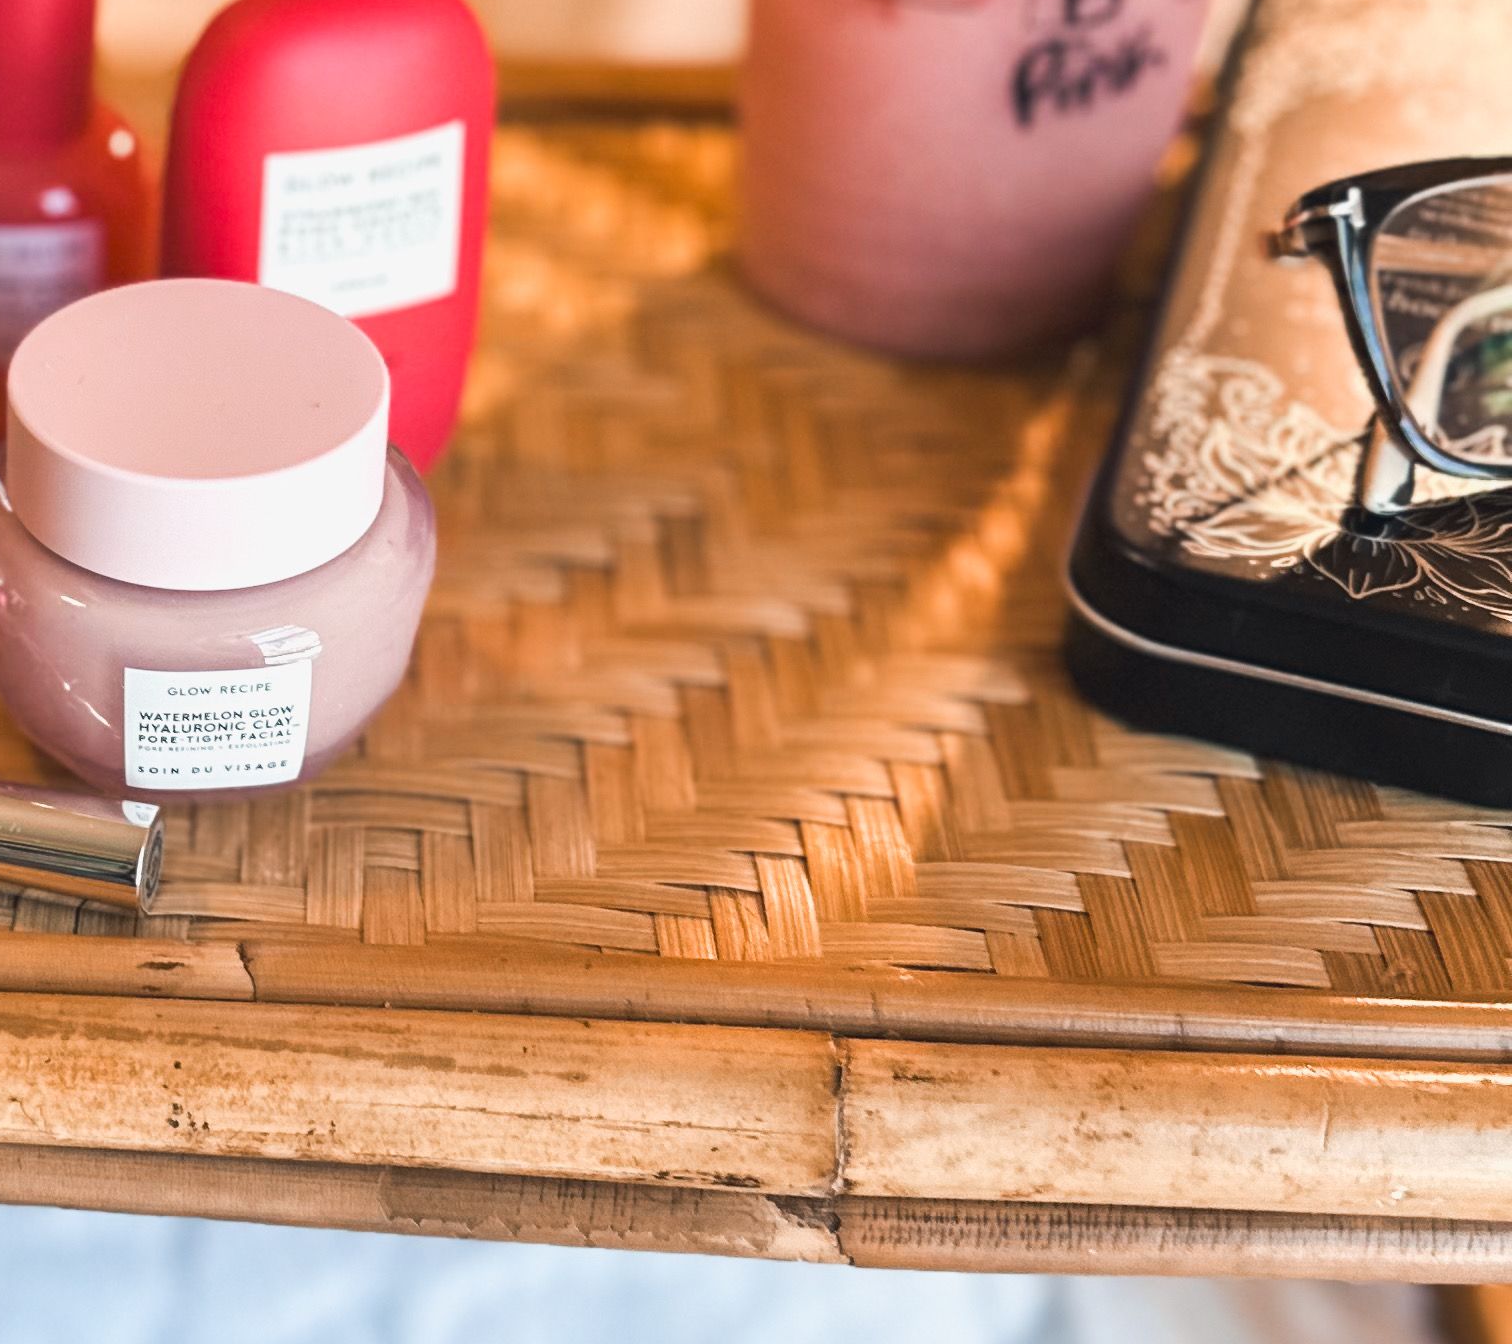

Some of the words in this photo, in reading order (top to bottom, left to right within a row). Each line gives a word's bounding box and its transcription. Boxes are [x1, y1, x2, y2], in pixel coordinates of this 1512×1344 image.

[167, 686, 212, 696] GLOW
[220, 682, 273, 695] RECIPE
[139, 710, 243, 722] WATERMELON
[249, 705, 295, 718] GLOW
[139, 721, 247, 734] HYALURONIC
[252, 716, 294, 730] CLAY
[240, 729, 292, 741] FACIAL
[138, 765, 180, 775] SOIN
[191, 766, 213, 774] DU
[224, 760, 288, 772] VISAGE
